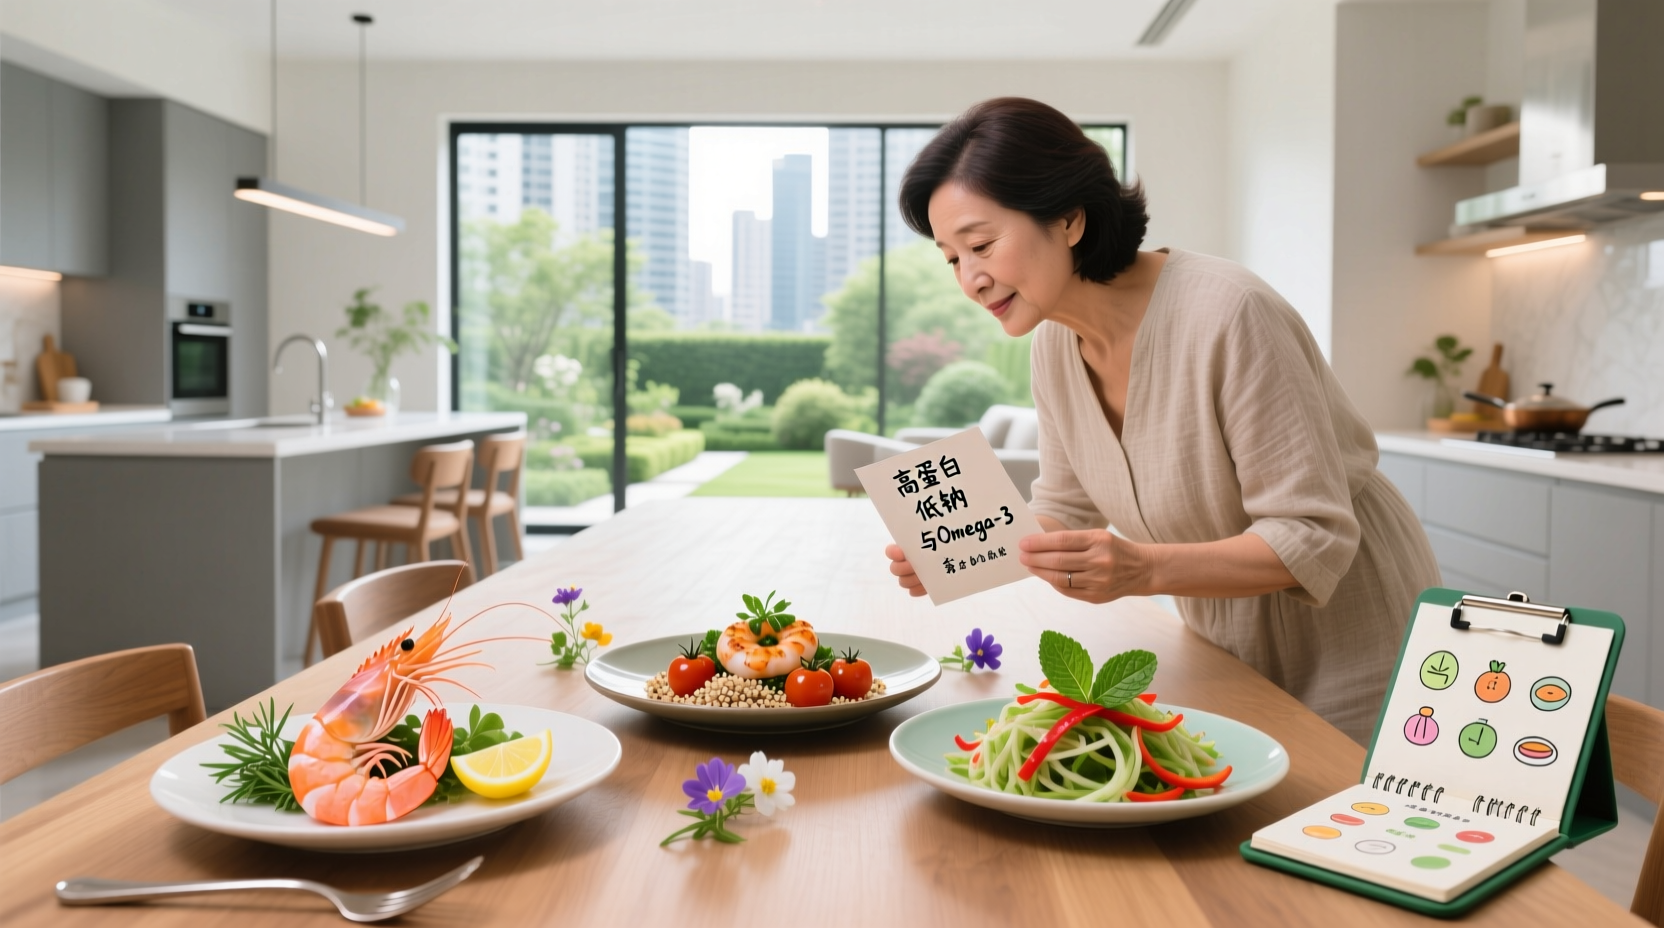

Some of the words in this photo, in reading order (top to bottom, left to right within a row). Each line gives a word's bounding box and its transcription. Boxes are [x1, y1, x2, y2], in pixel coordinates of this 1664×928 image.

[893, 455, 961, 497] 高蛋白
[916, 486, 968, 521] 低钠
